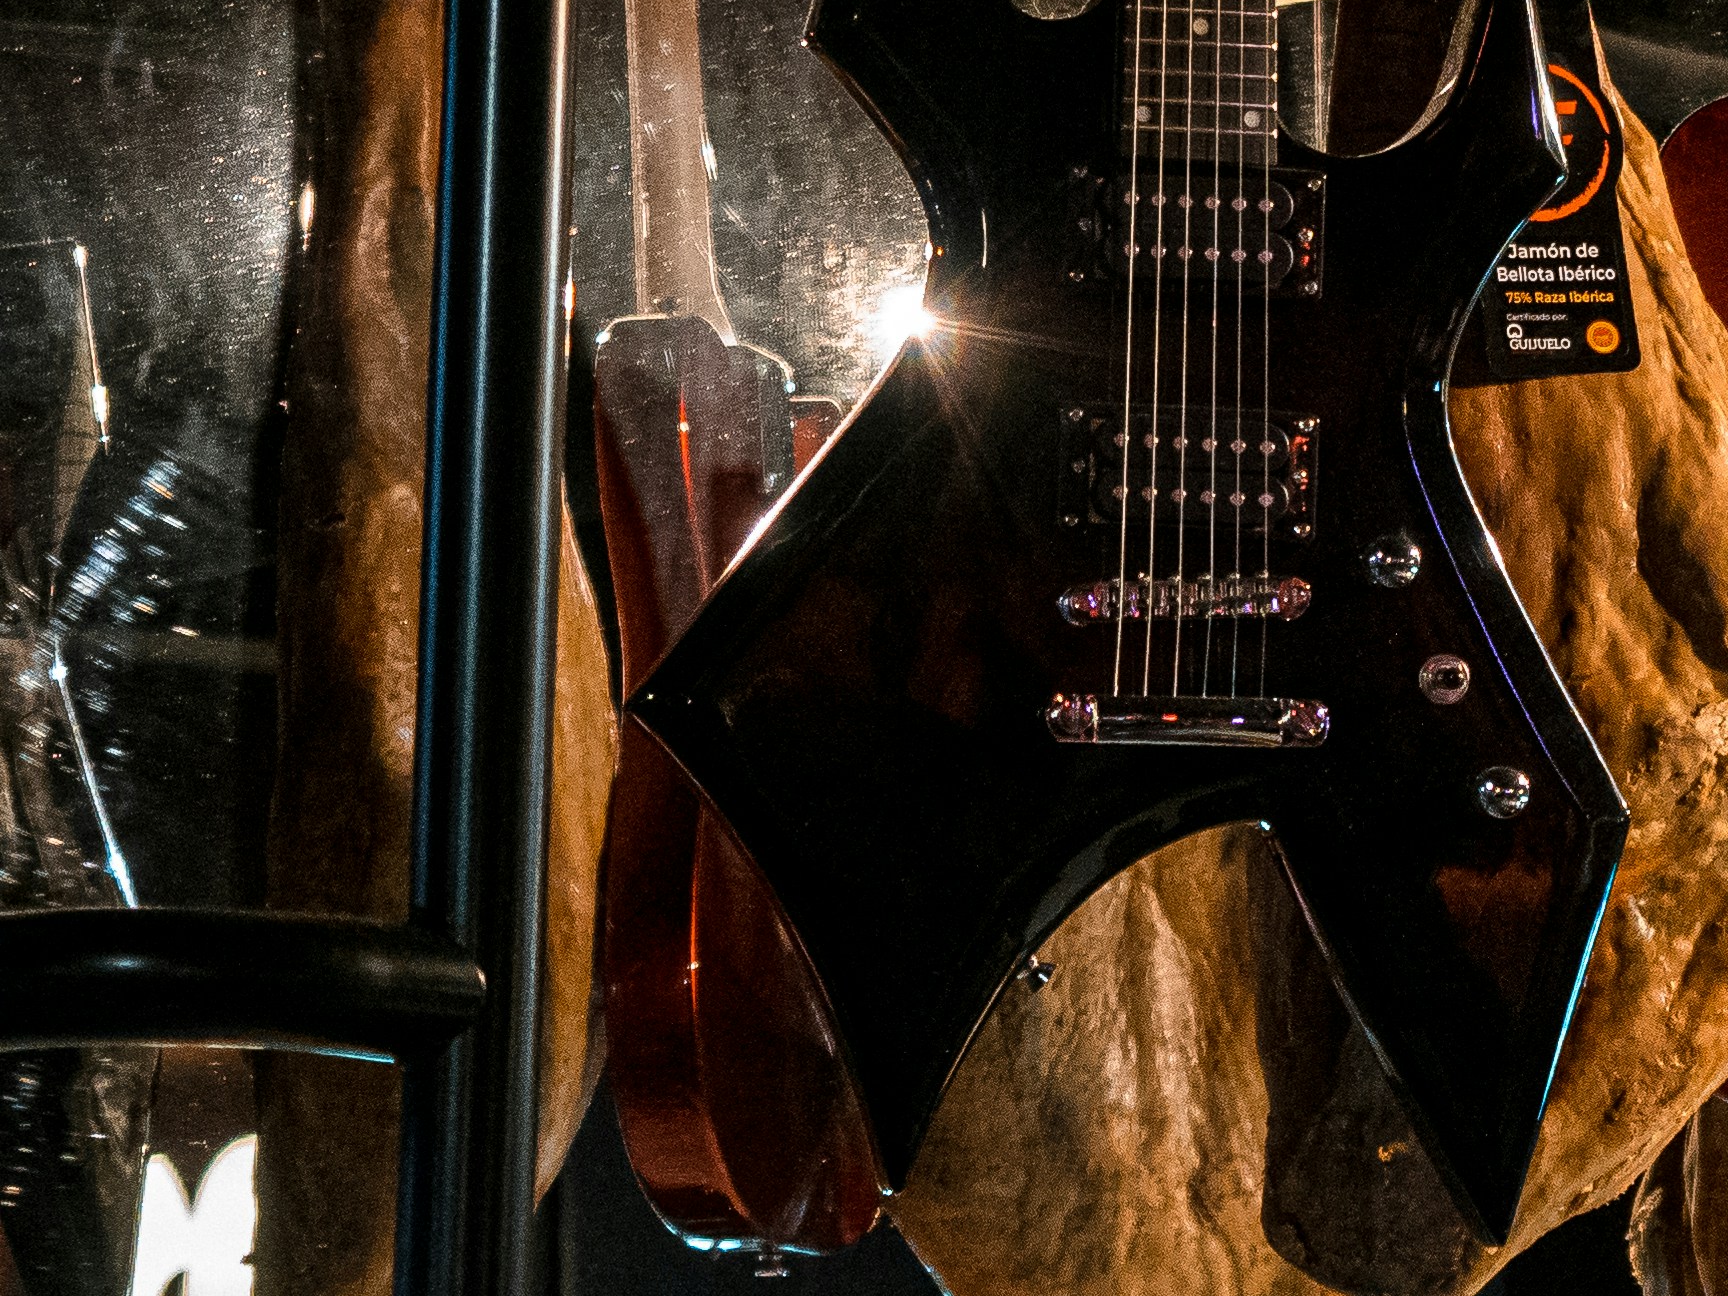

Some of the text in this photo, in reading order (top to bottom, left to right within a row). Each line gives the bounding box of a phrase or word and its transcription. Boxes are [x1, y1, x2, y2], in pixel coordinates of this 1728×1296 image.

[1508, 242, 1599, 259] Jamón de
[1496, 264, 1616, 282] Bellota Ibérico
[1505, 289, 1615, 304] 75% Raza Ibérica
[1509, 338, 1571, 351] GUIJUELO
